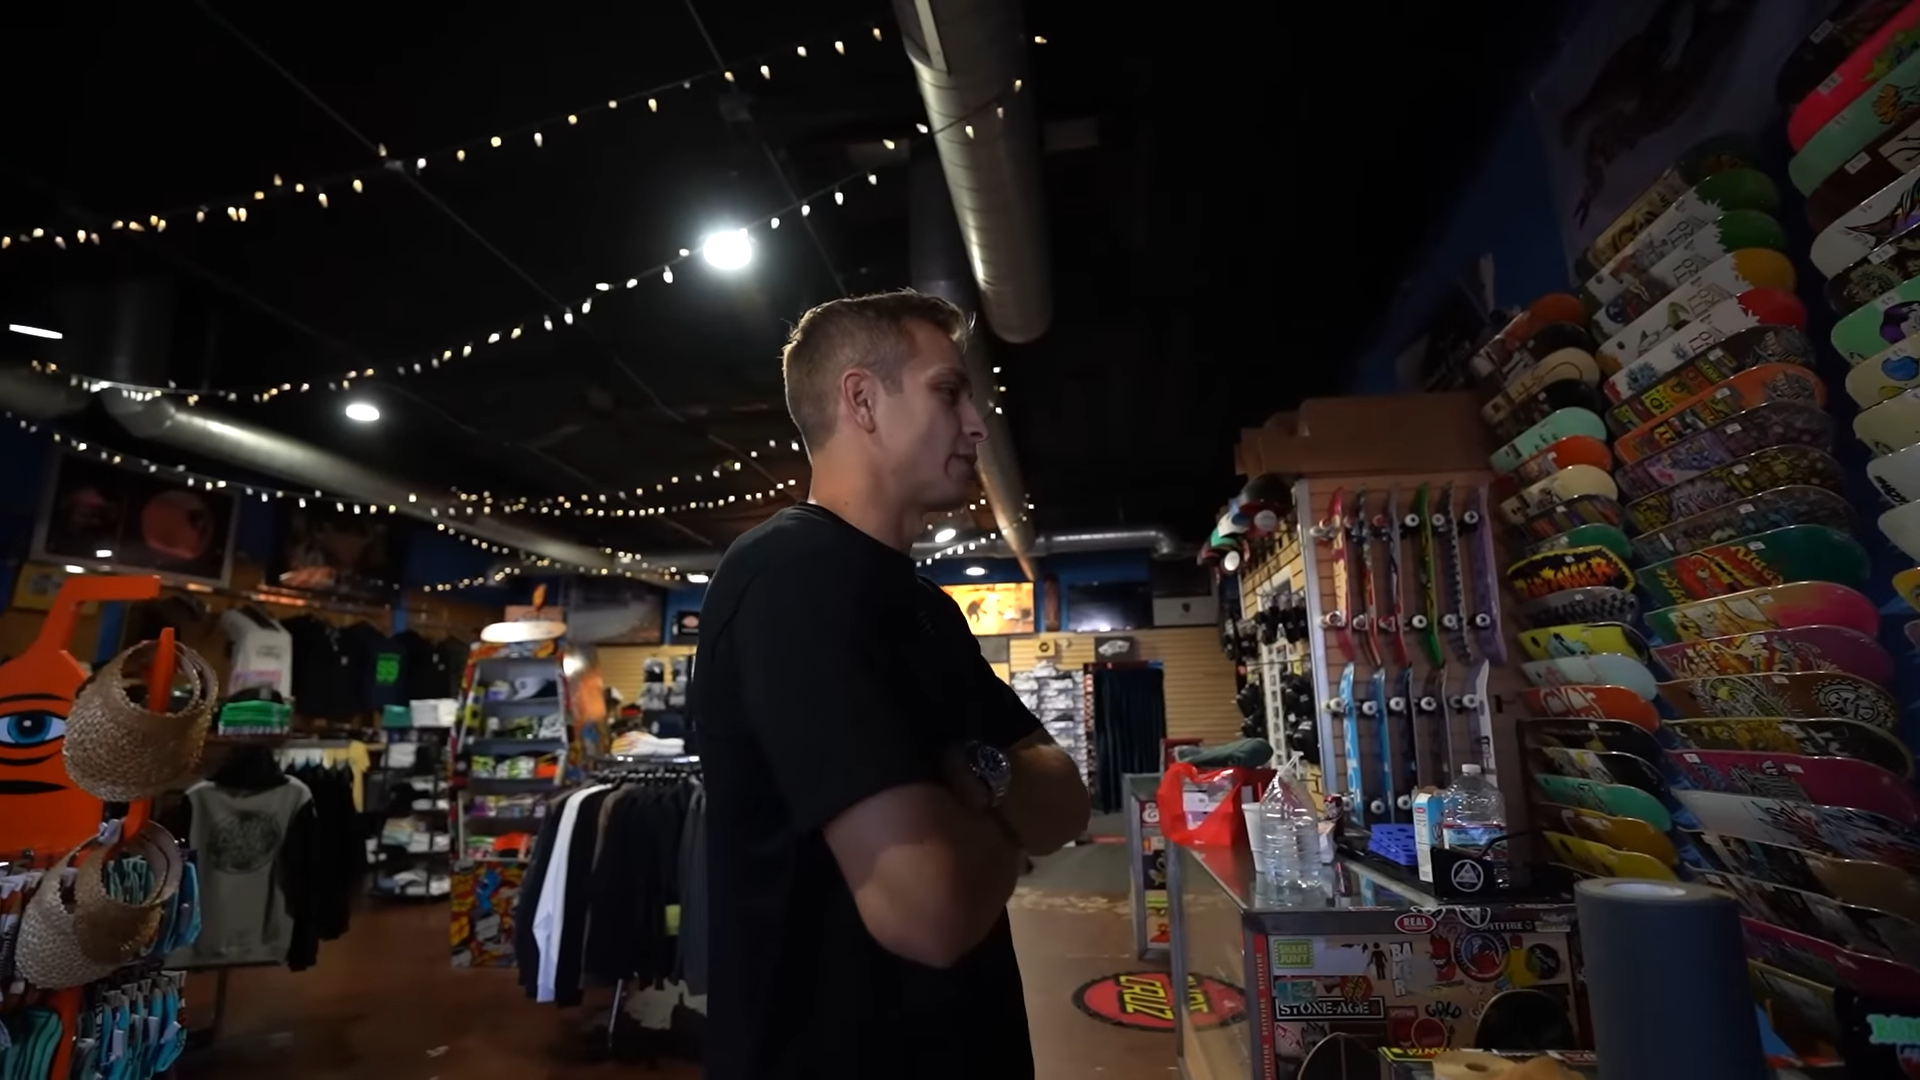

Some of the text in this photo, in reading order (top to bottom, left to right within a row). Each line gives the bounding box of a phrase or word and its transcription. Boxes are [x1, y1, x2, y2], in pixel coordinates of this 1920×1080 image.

[1402, 917, 1428, 927] REAL
[1279, 953, 1308, 964] JUNT
[1118, 975, 1174, 1020] CRUZ
[1280, 1001, 1370, 1015] STONE-AGE
[1425, 1000, 1462, 1018] GOLD
